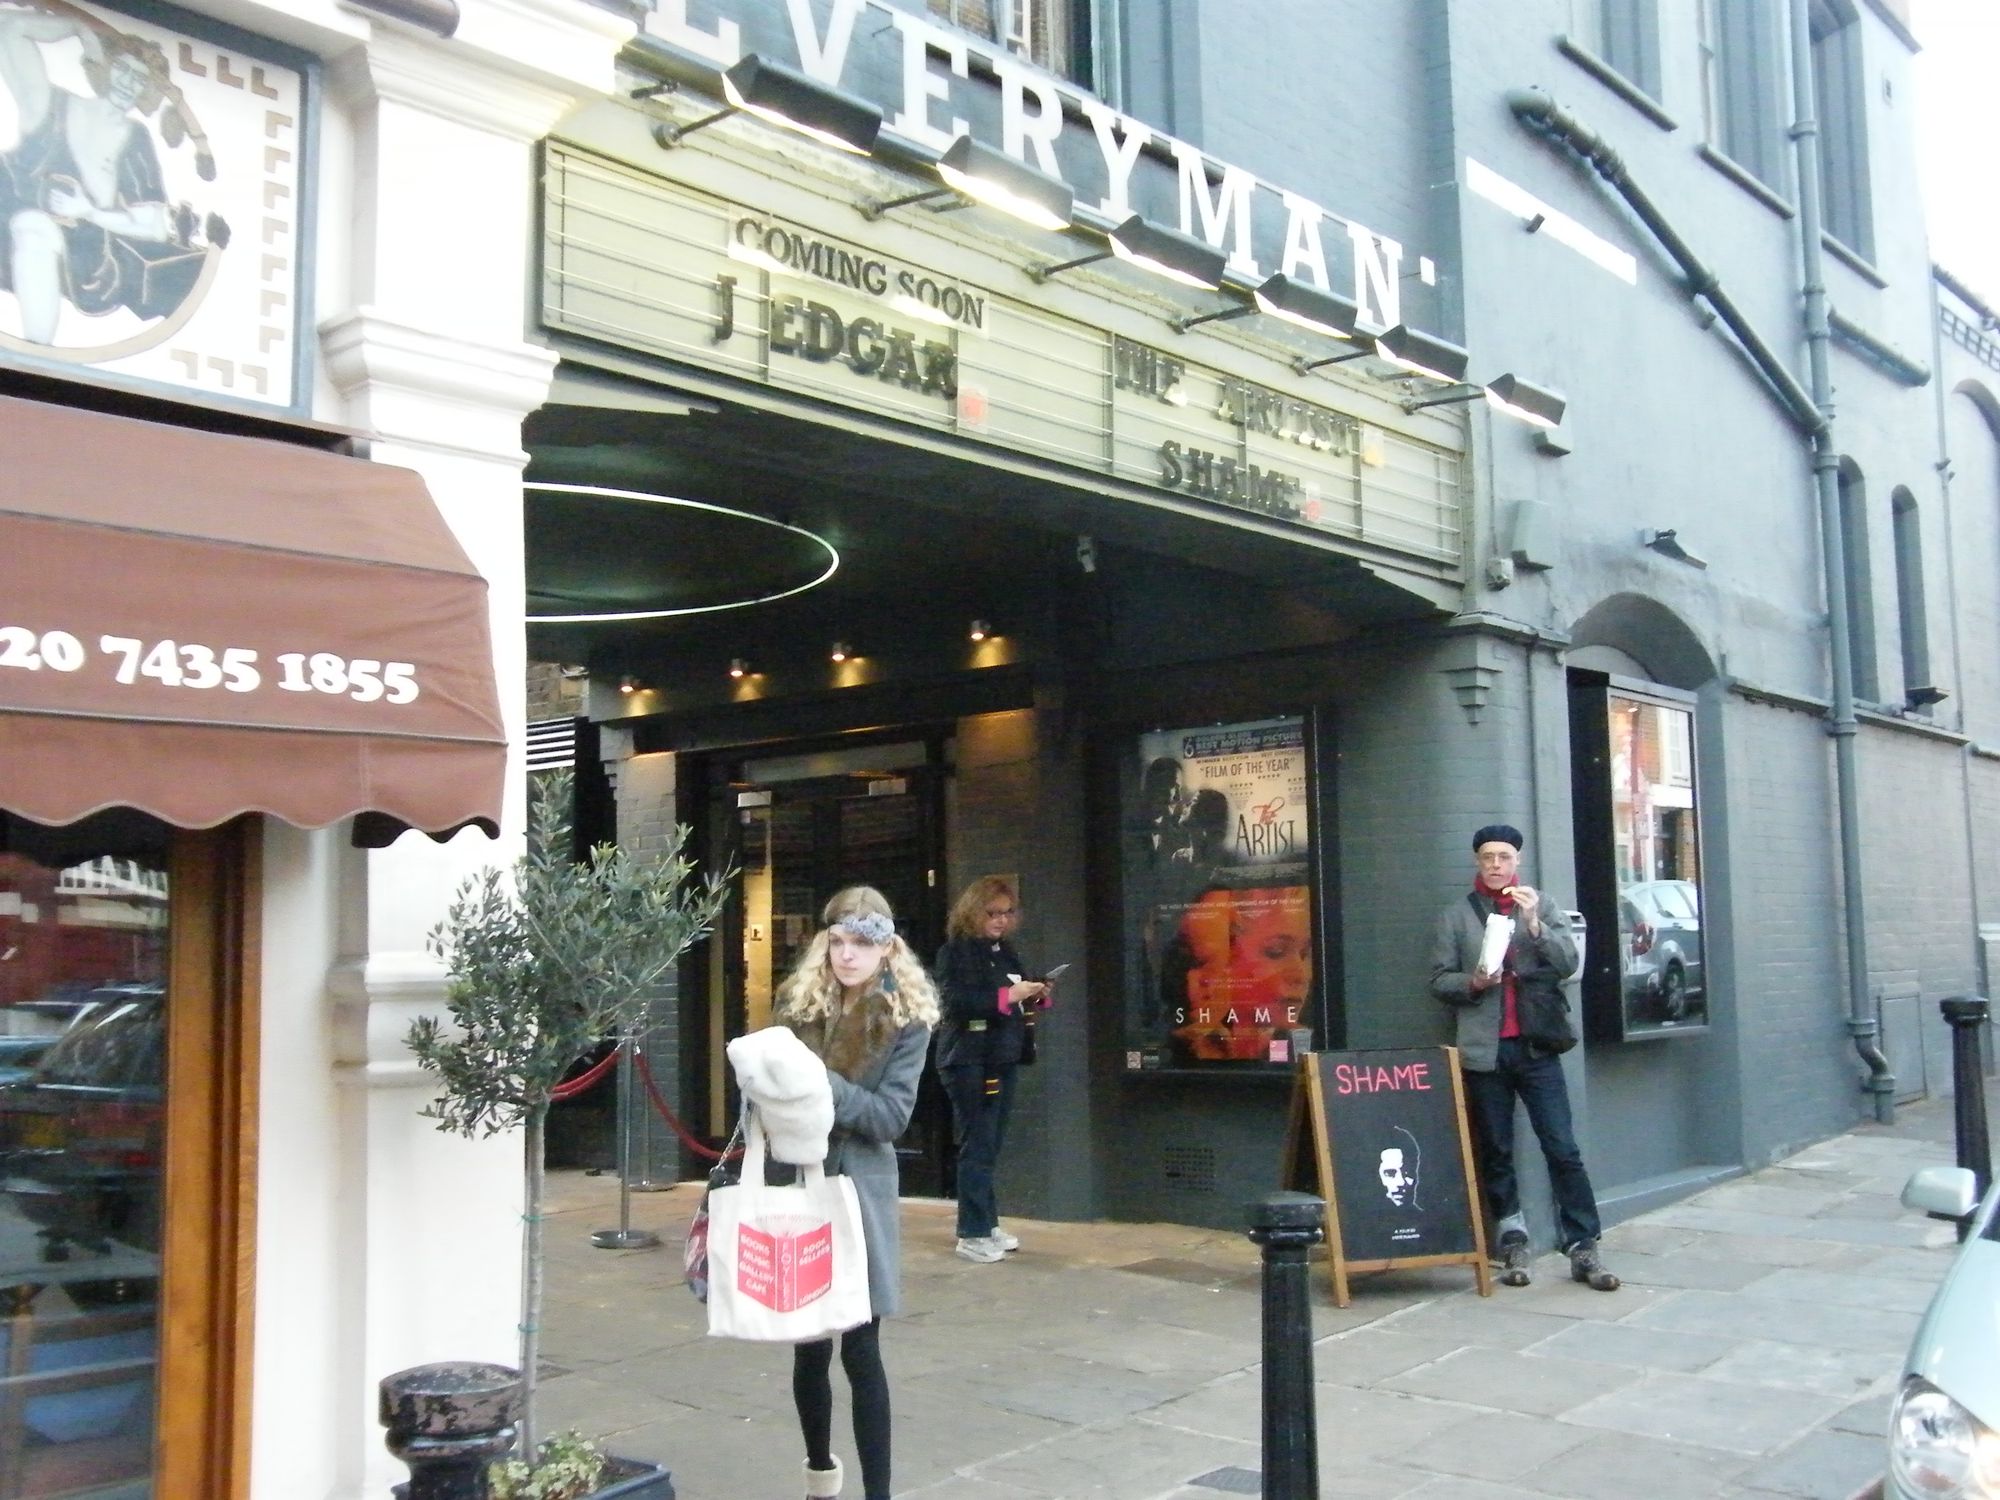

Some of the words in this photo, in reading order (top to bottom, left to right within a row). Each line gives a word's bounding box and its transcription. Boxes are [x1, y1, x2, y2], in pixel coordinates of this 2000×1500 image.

[735, 217, 887, 296] COMING
[897, 270, 985, 329] SOON
[715, 272, 738, 341] J
[770, 293, 958, 400] EDGAR
[1162, 439, 1301, 521] SHAME
[0, 626, 85, 672] 20
[100, 634, 261, 693] 7435
[276, 652, 420, 704] 1855
[1230, 763, 1243, 776] OF
[1246, 760, 1264, 775] THE
[1236, 813, 1296, 857] ARTIST
[1335, 1063, 1432, 1095] SHAME
